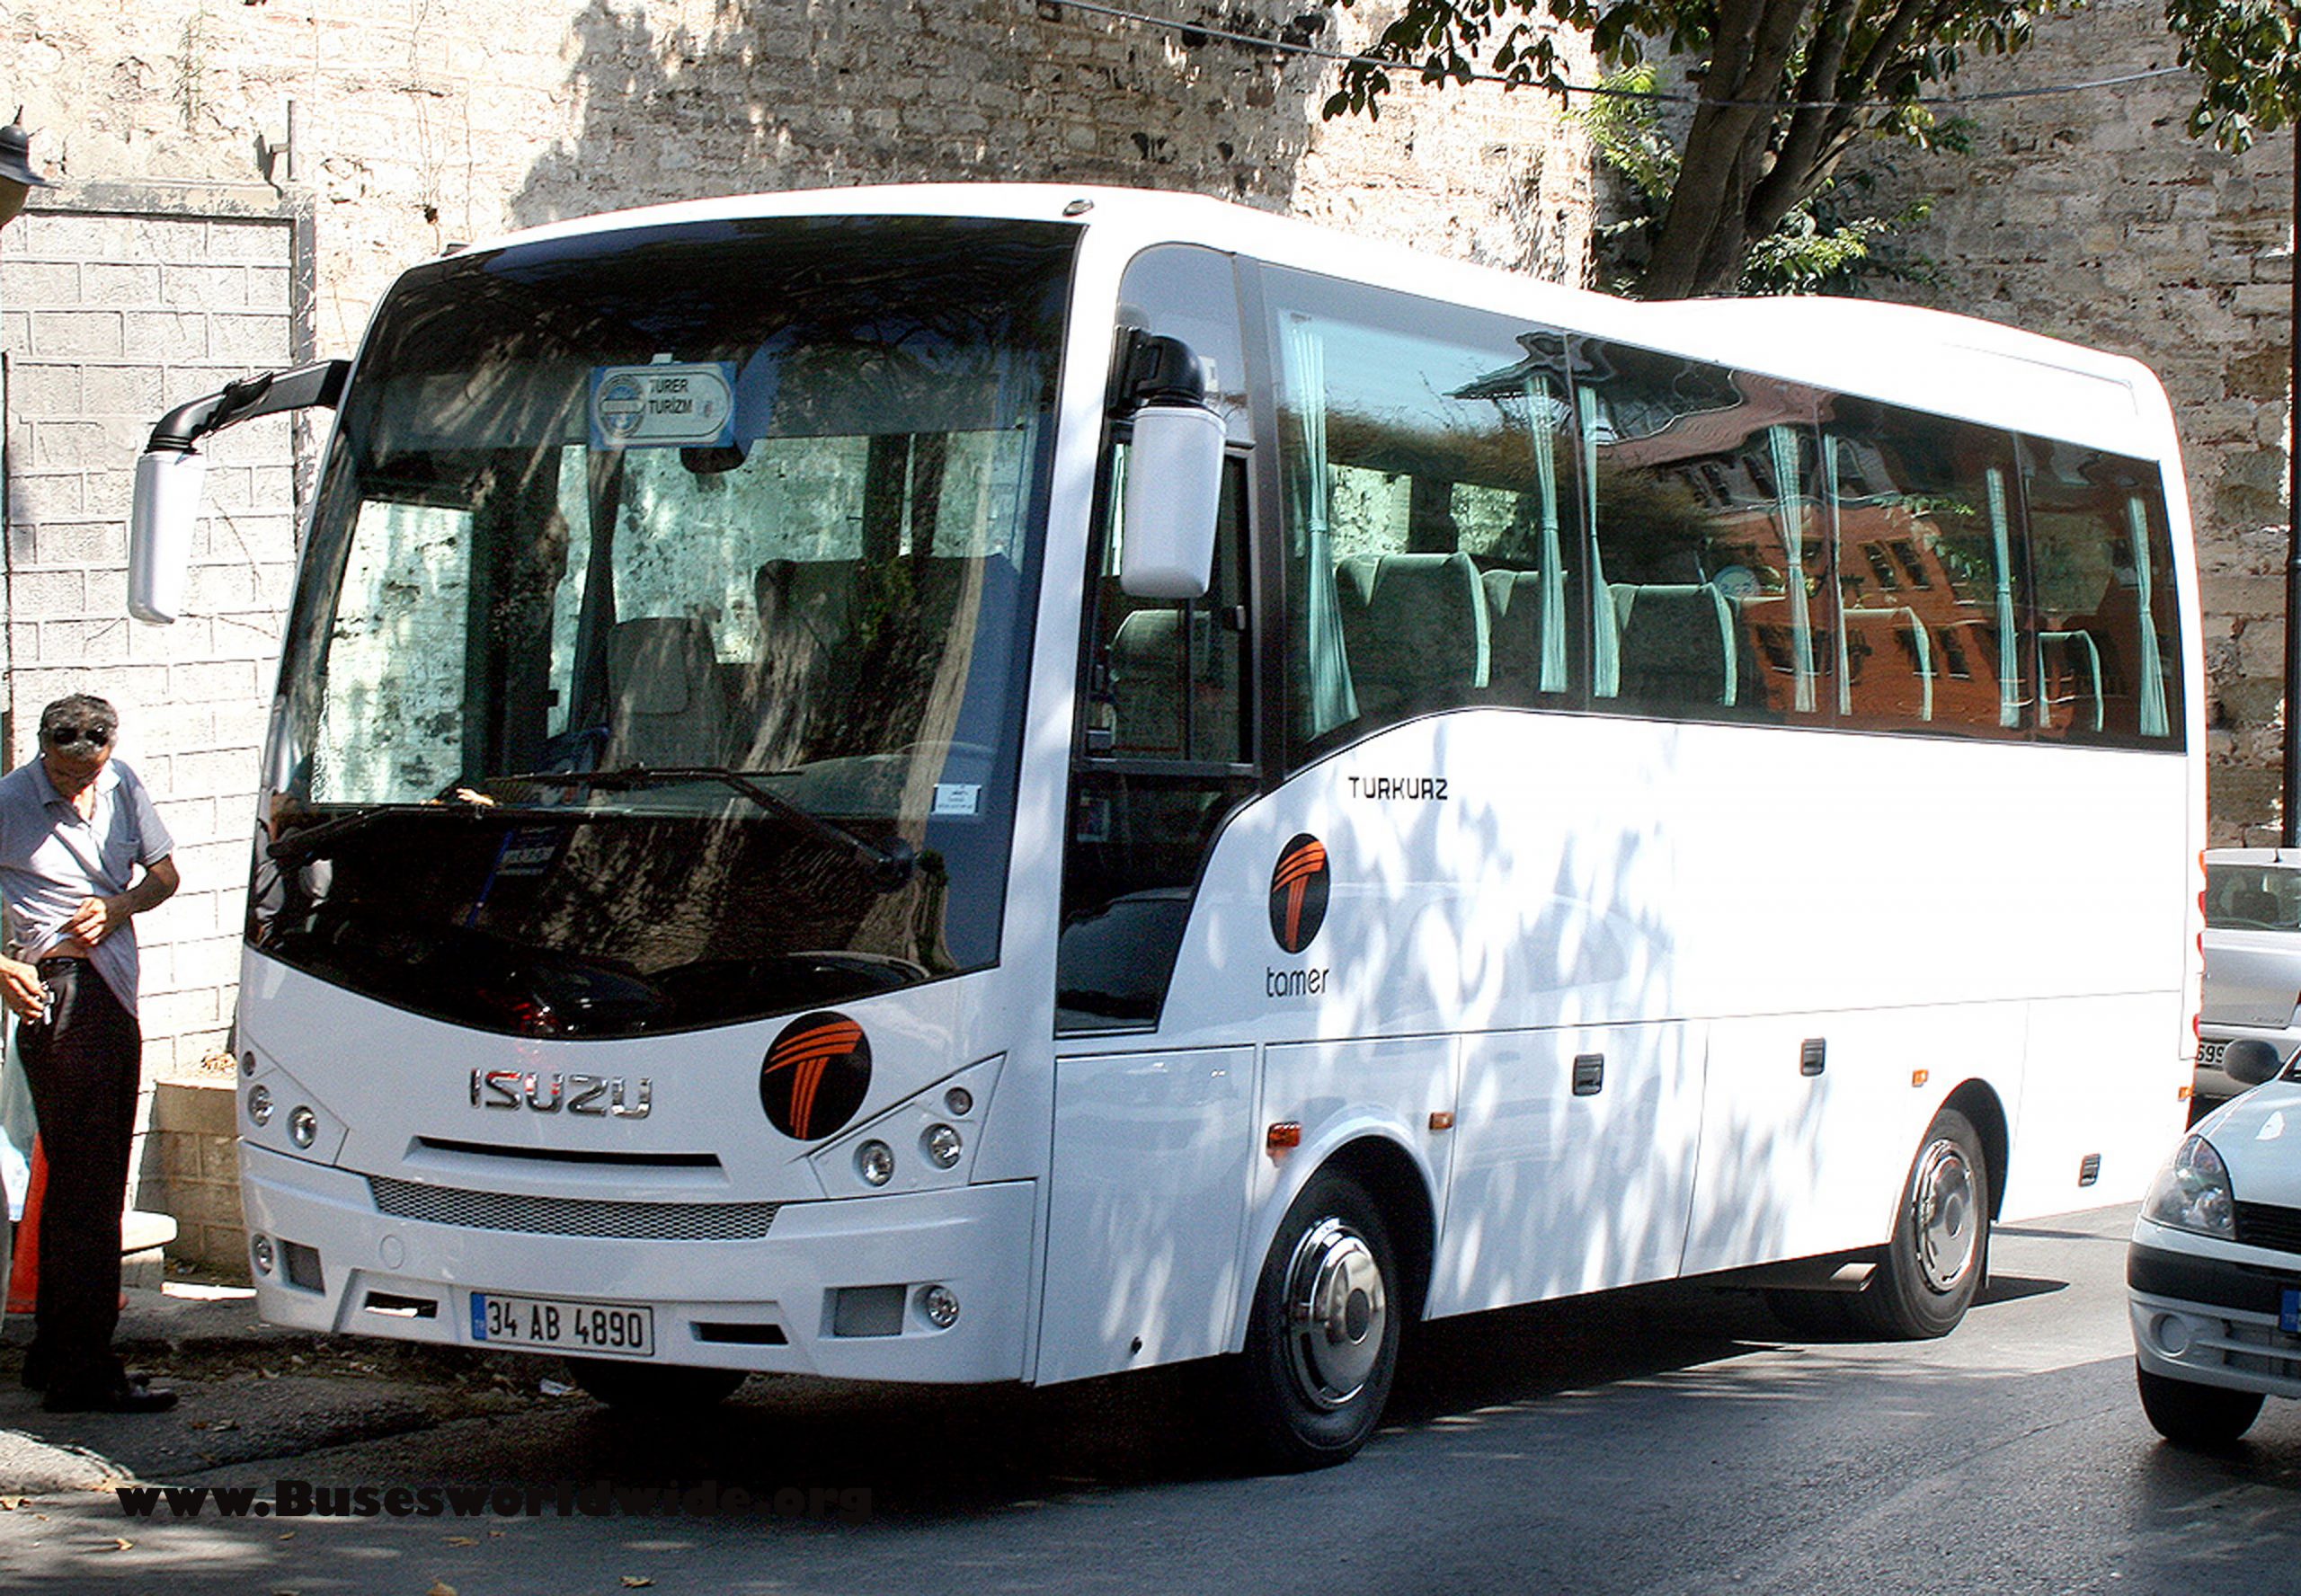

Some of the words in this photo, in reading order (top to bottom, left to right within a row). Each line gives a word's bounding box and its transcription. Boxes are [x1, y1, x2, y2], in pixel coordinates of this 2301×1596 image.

[1266, 966, 1329, 998] tamer
[470, 1068, 653, 1120] ISUZU
[488, 1300, 517, 1337] 34
[530, 1305, 560, 1341] AB
[574, 1308, 643, 1348] 4890
